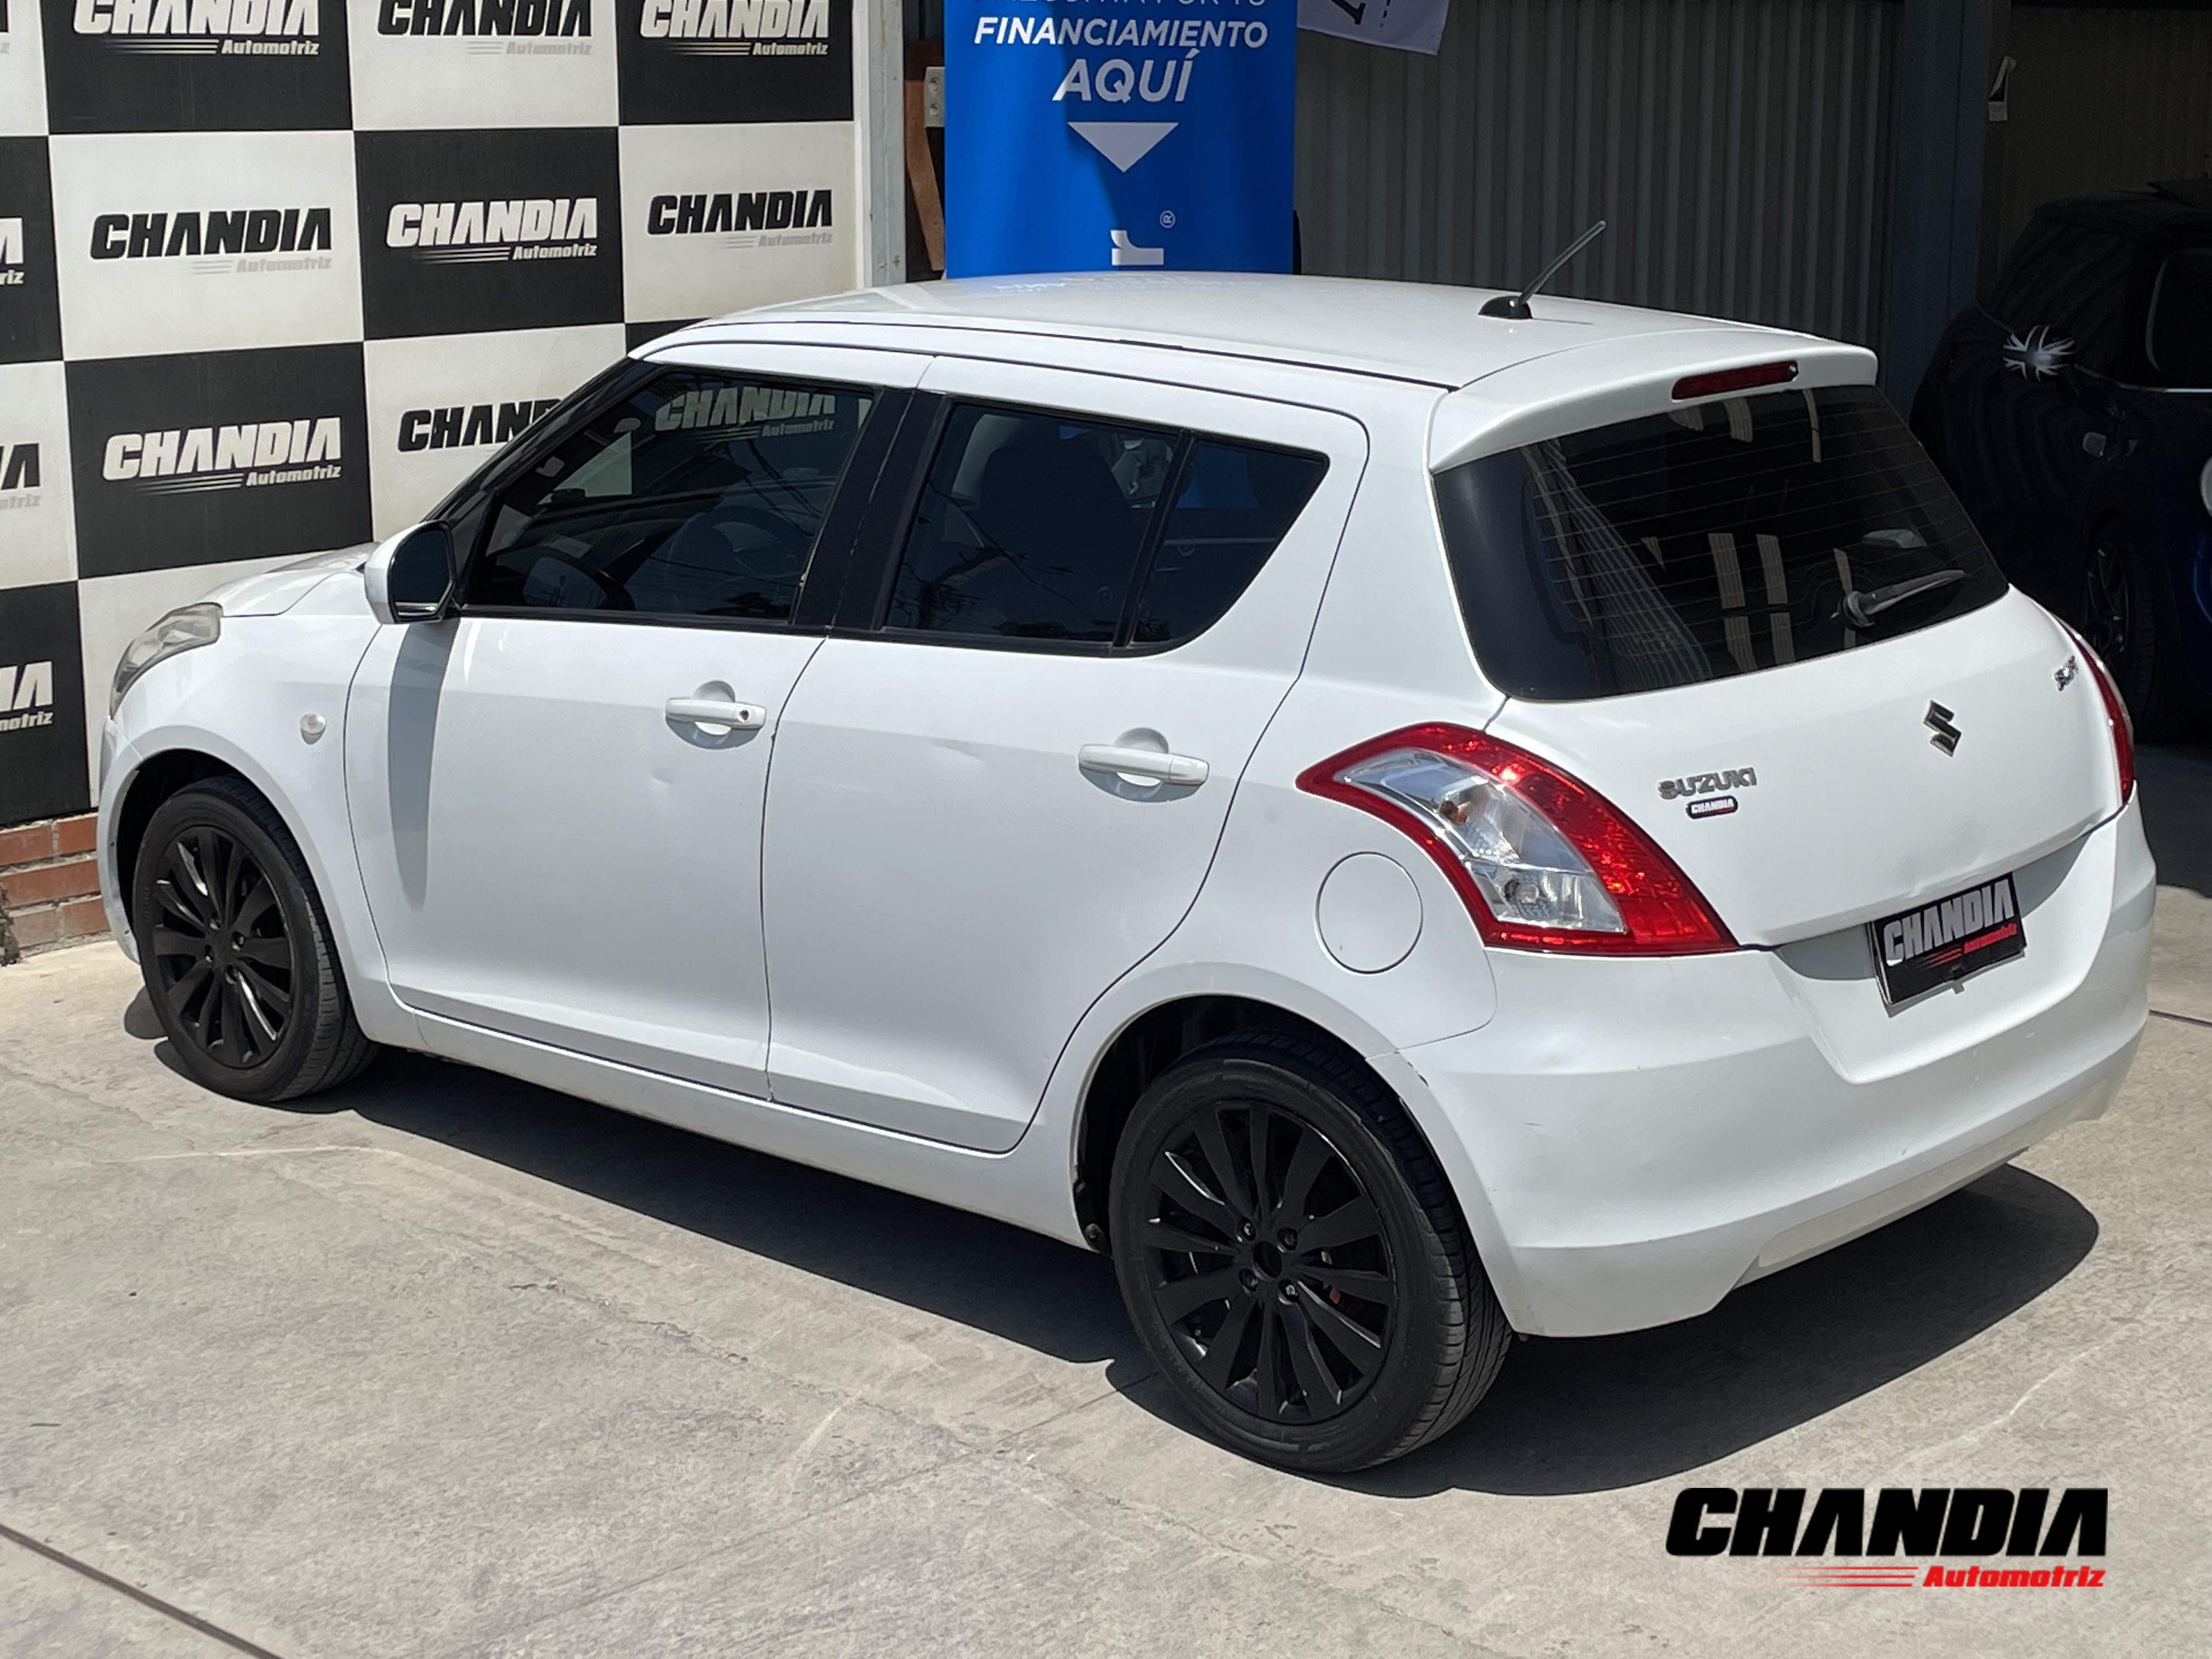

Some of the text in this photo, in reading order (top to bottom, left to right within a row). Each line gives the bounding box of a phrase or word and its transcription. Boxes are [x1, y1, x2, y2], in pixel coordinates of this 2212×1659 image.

[73, 0, 320, 35] CHANDIA
[377, 0, 592, 37] CHANDIA
[640, 0, 829, 38] CHANDIA
[974, 16, 1268, 48] FINANCIAMIENTO
[221, 39, 320, 55] Automotriz
[506, 41, 592, 55] Automotriz
[752, 42, 829, 55] Automotriz
[1052, 48, 1200, 103] AQUÍ
[386, 198, 598, 248] CHANDIA
[647, 189, 832, 235] CHANDIA
[90, 208, 332, 259] CHANDIA
[235, 256, 332, 274] Automotriz
[512, 243, 598, 261] Automotriz
[397, 398, 562, 452] CHAN
[103, 416, 341, 481] CHANDIA
[246, 464, 342, 487] Automotriz
[1657, 767, 1758, 800] SUZUKI
[1883, 878, 2015, 967] CHANDIA
